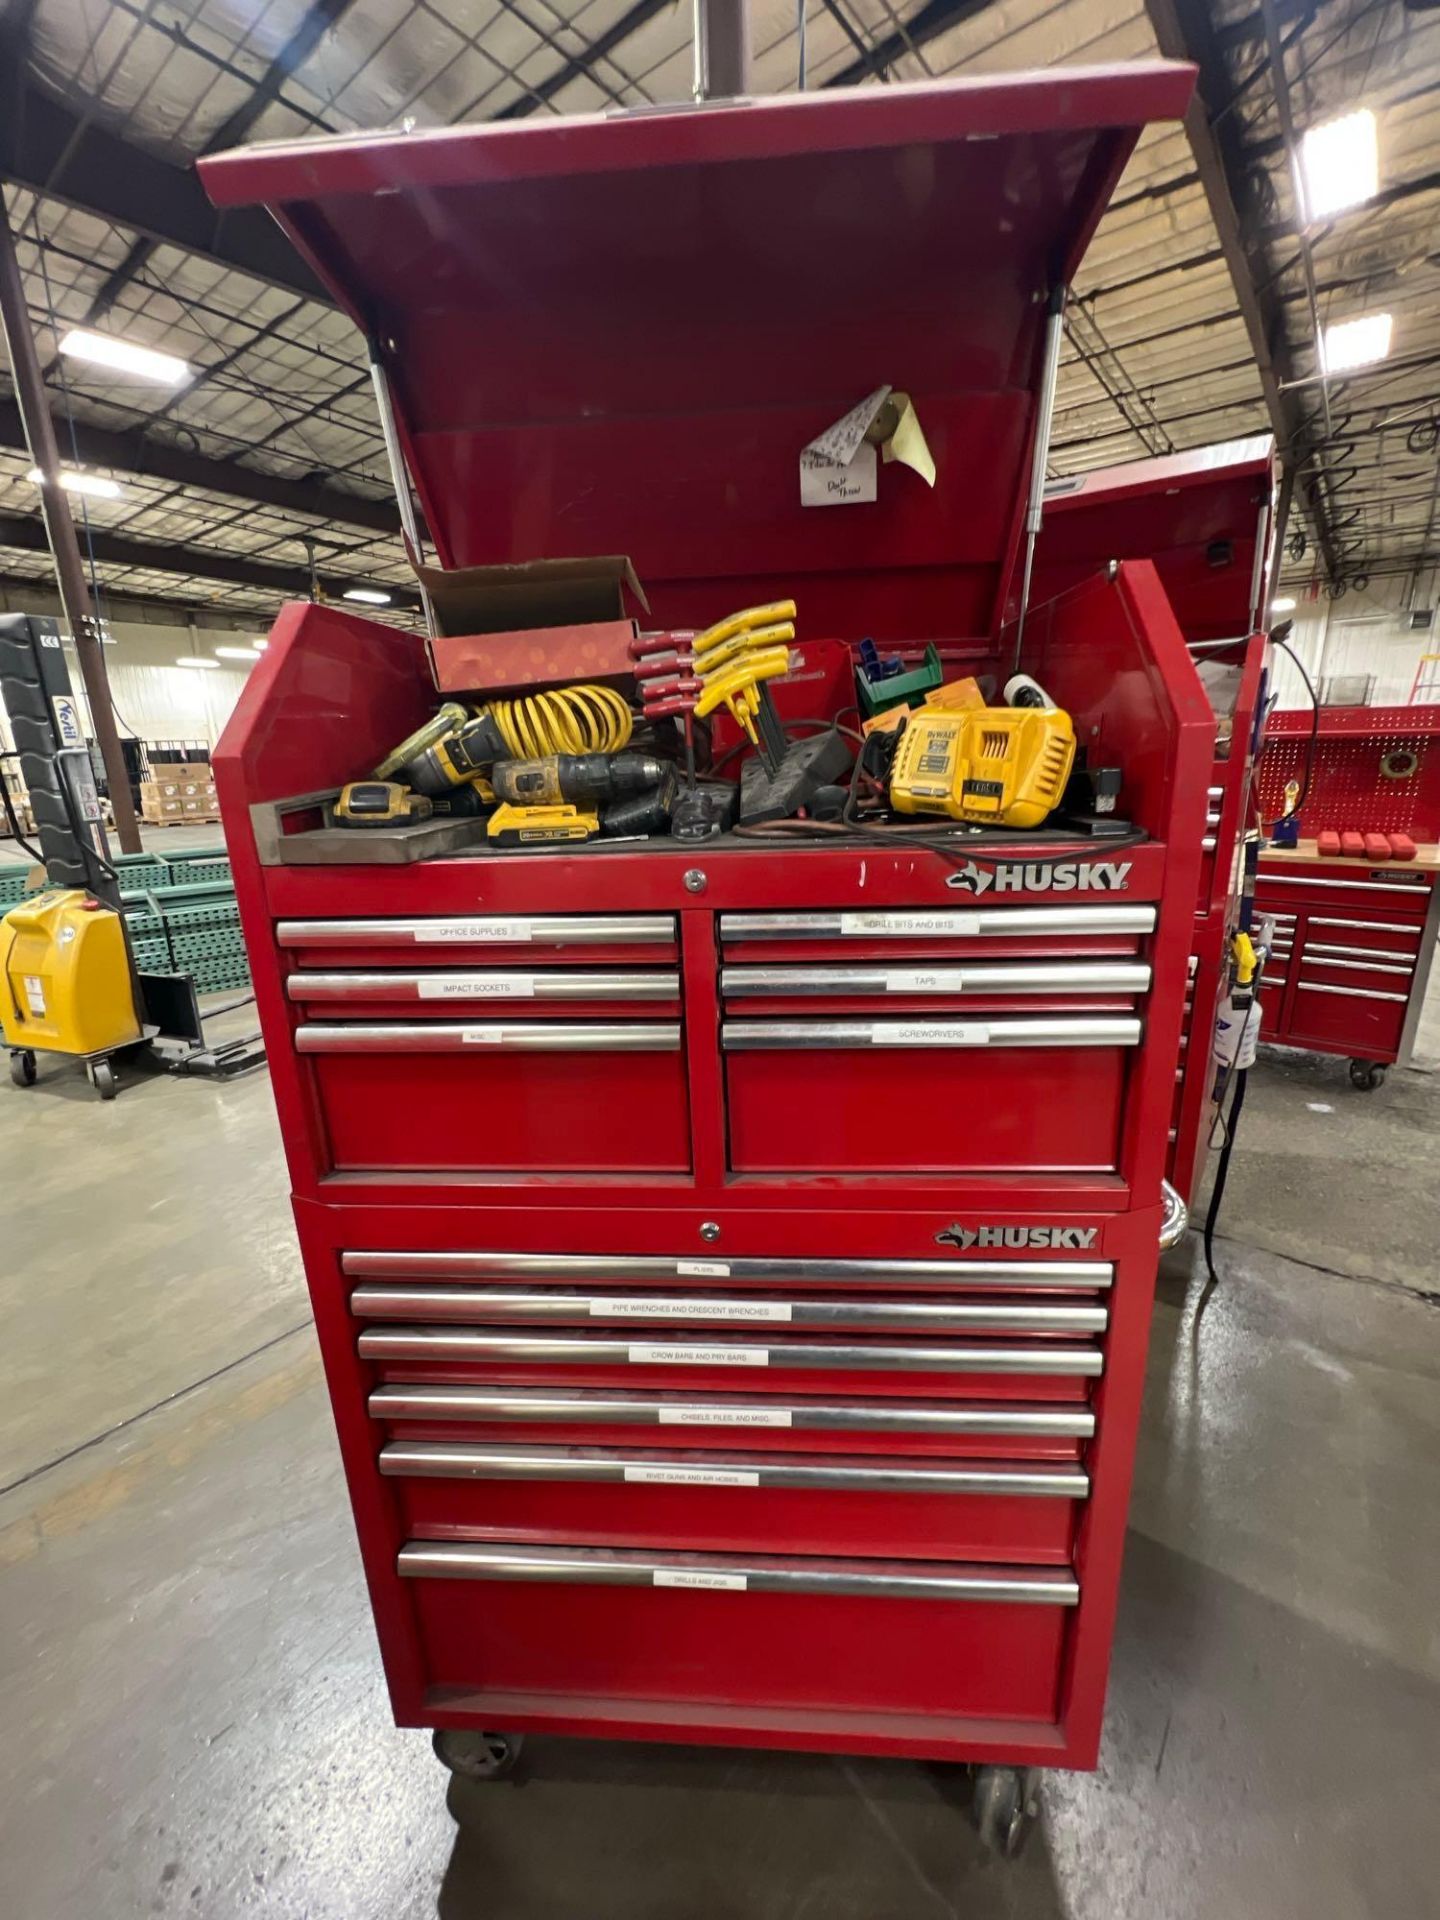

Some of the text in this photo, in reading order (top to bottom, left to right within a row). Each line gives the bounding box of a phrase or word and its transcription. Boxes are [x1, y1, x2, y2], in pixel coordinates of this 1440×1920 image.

[59, 703, 77, 739] Vestil
[994, 862, 1133, 892] HUSKY
[915, 920, 934, 929] AND
[440, 927, 508, 936] OFFICE SUPPLIES
[914, 976, 937, 986] TAPS
[443, 983, 511, 993] IMPACT SOCKETS
[898, 1029, 965, 1039] SCREWDRIVERS
[978, 1226, 1098, 1249] HUSKY
[612, 1303, 770, 1316] PIPE WRENCHES AND CRESCENT WRENCHES
[651, 1351, 673, 1360] CROW
[695, 1353, 711, 1361] AND
[711, 1353, 726, 1361] PRY
[727, 1354, 747, 1362] BARS
[735, 1414, 750, 1422] AND
[646, 1472, 665, 1480] RIVET
